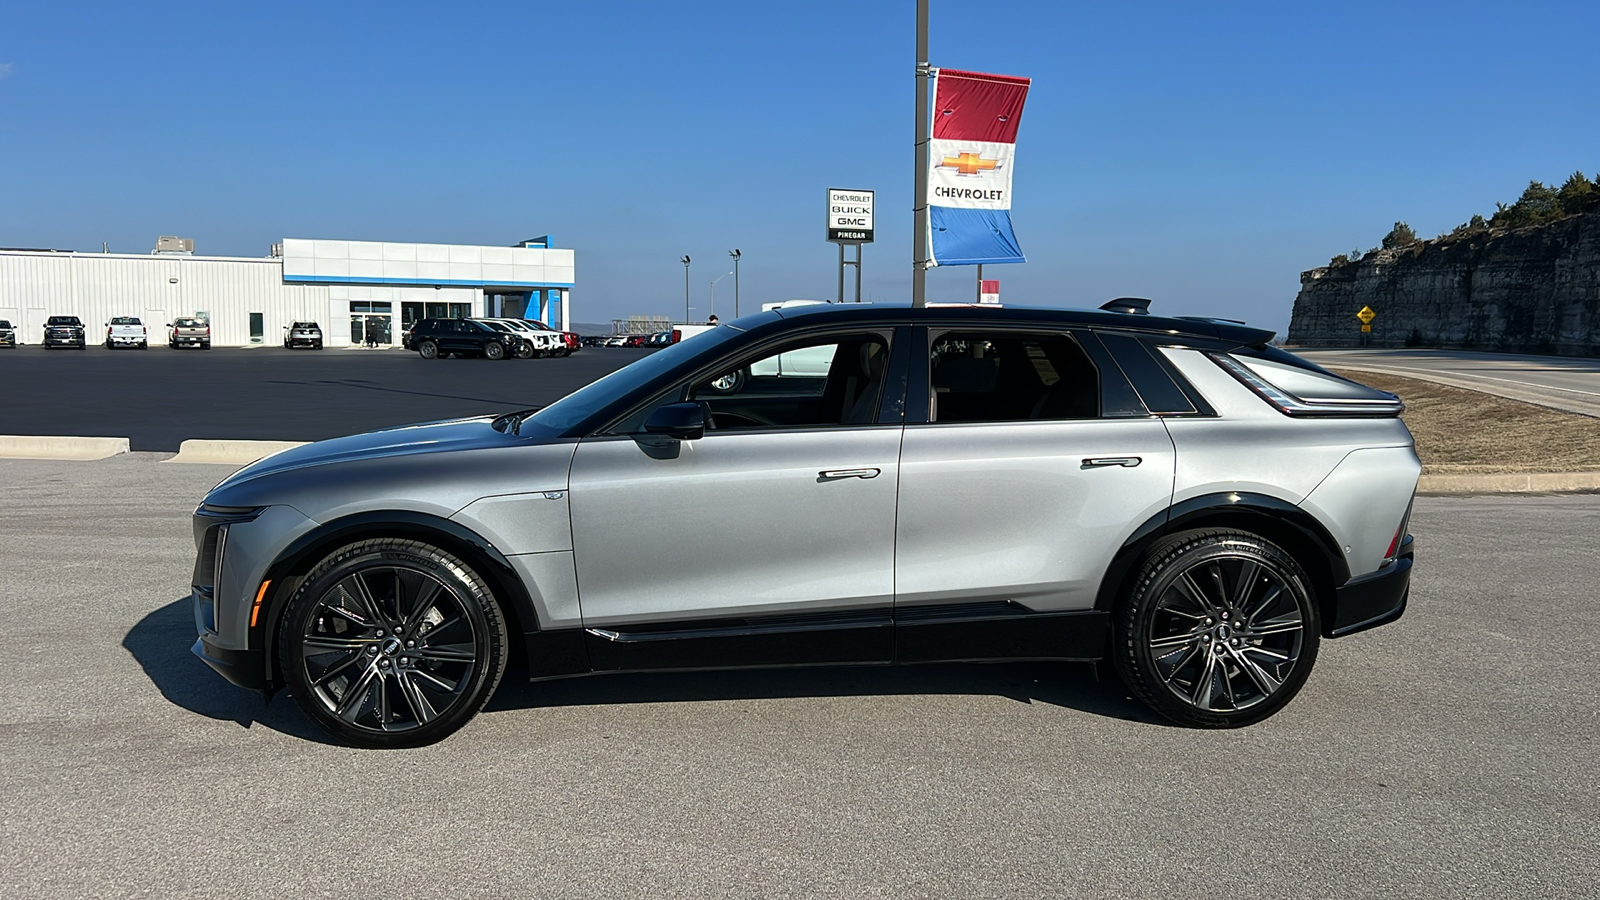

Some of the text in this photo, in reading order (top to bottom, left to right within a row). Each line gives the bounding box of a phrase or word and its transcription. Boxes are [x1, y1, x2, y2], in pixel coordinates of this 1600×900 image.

[833, 194, 870, 202] CHEVROLET
[935, 187, 1002, 200] CHEVROLET
[832, 206, 870, 214] BUICK
[1236, 545, 1271, 558] MICHELIN
[400, 554, 437, 569] MICHELIN
